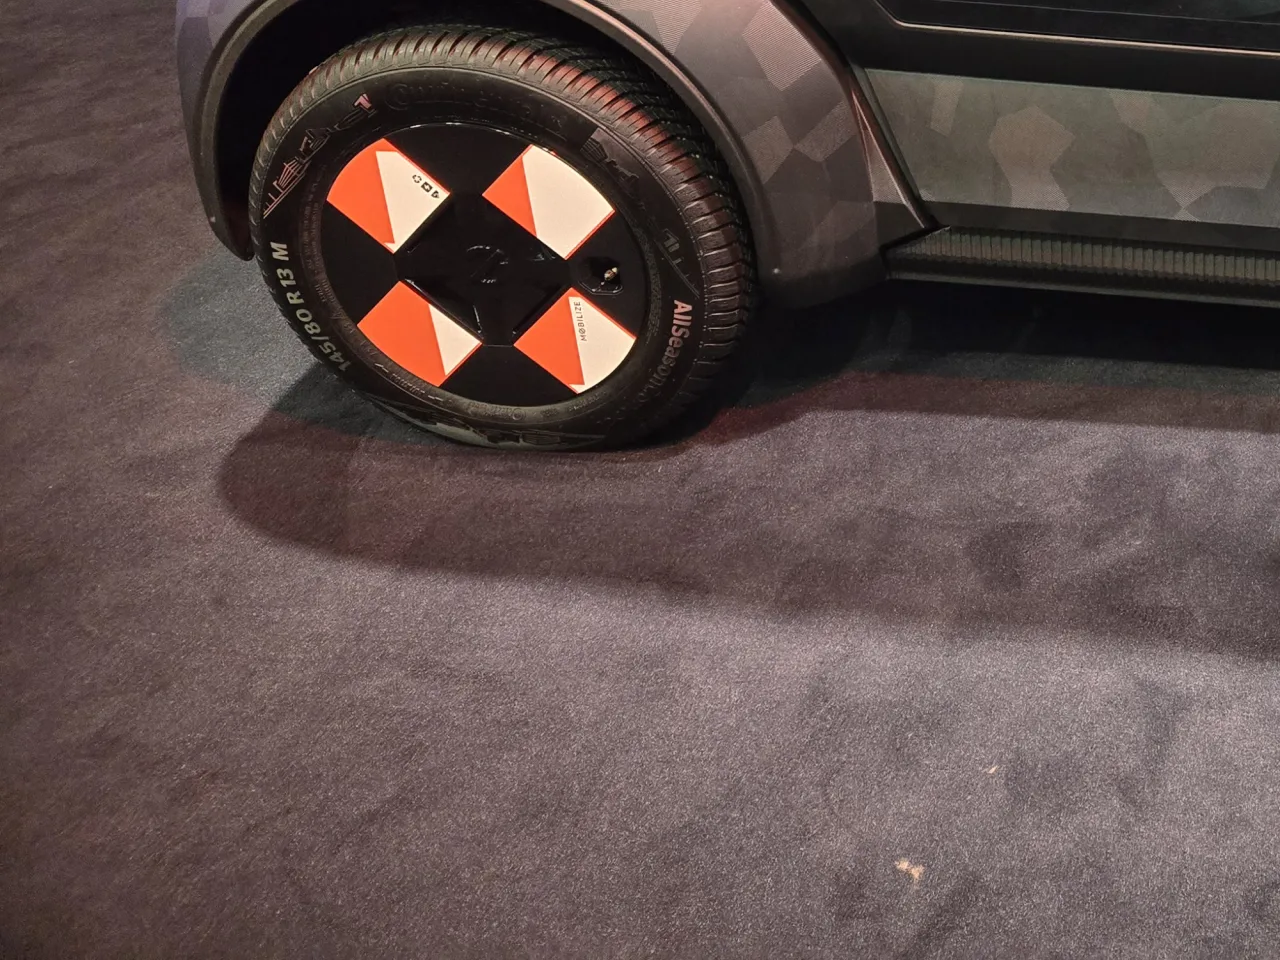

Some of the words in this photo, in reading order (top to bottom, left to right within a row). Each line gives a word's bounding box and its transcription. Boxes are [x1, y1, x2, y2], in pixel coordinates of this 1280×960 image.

[270, 241, 290, 261] M
[276, 268, 297, 287] 13
[286, 291, 305, 305] R
[296, 308, 351, 371] 145/80
